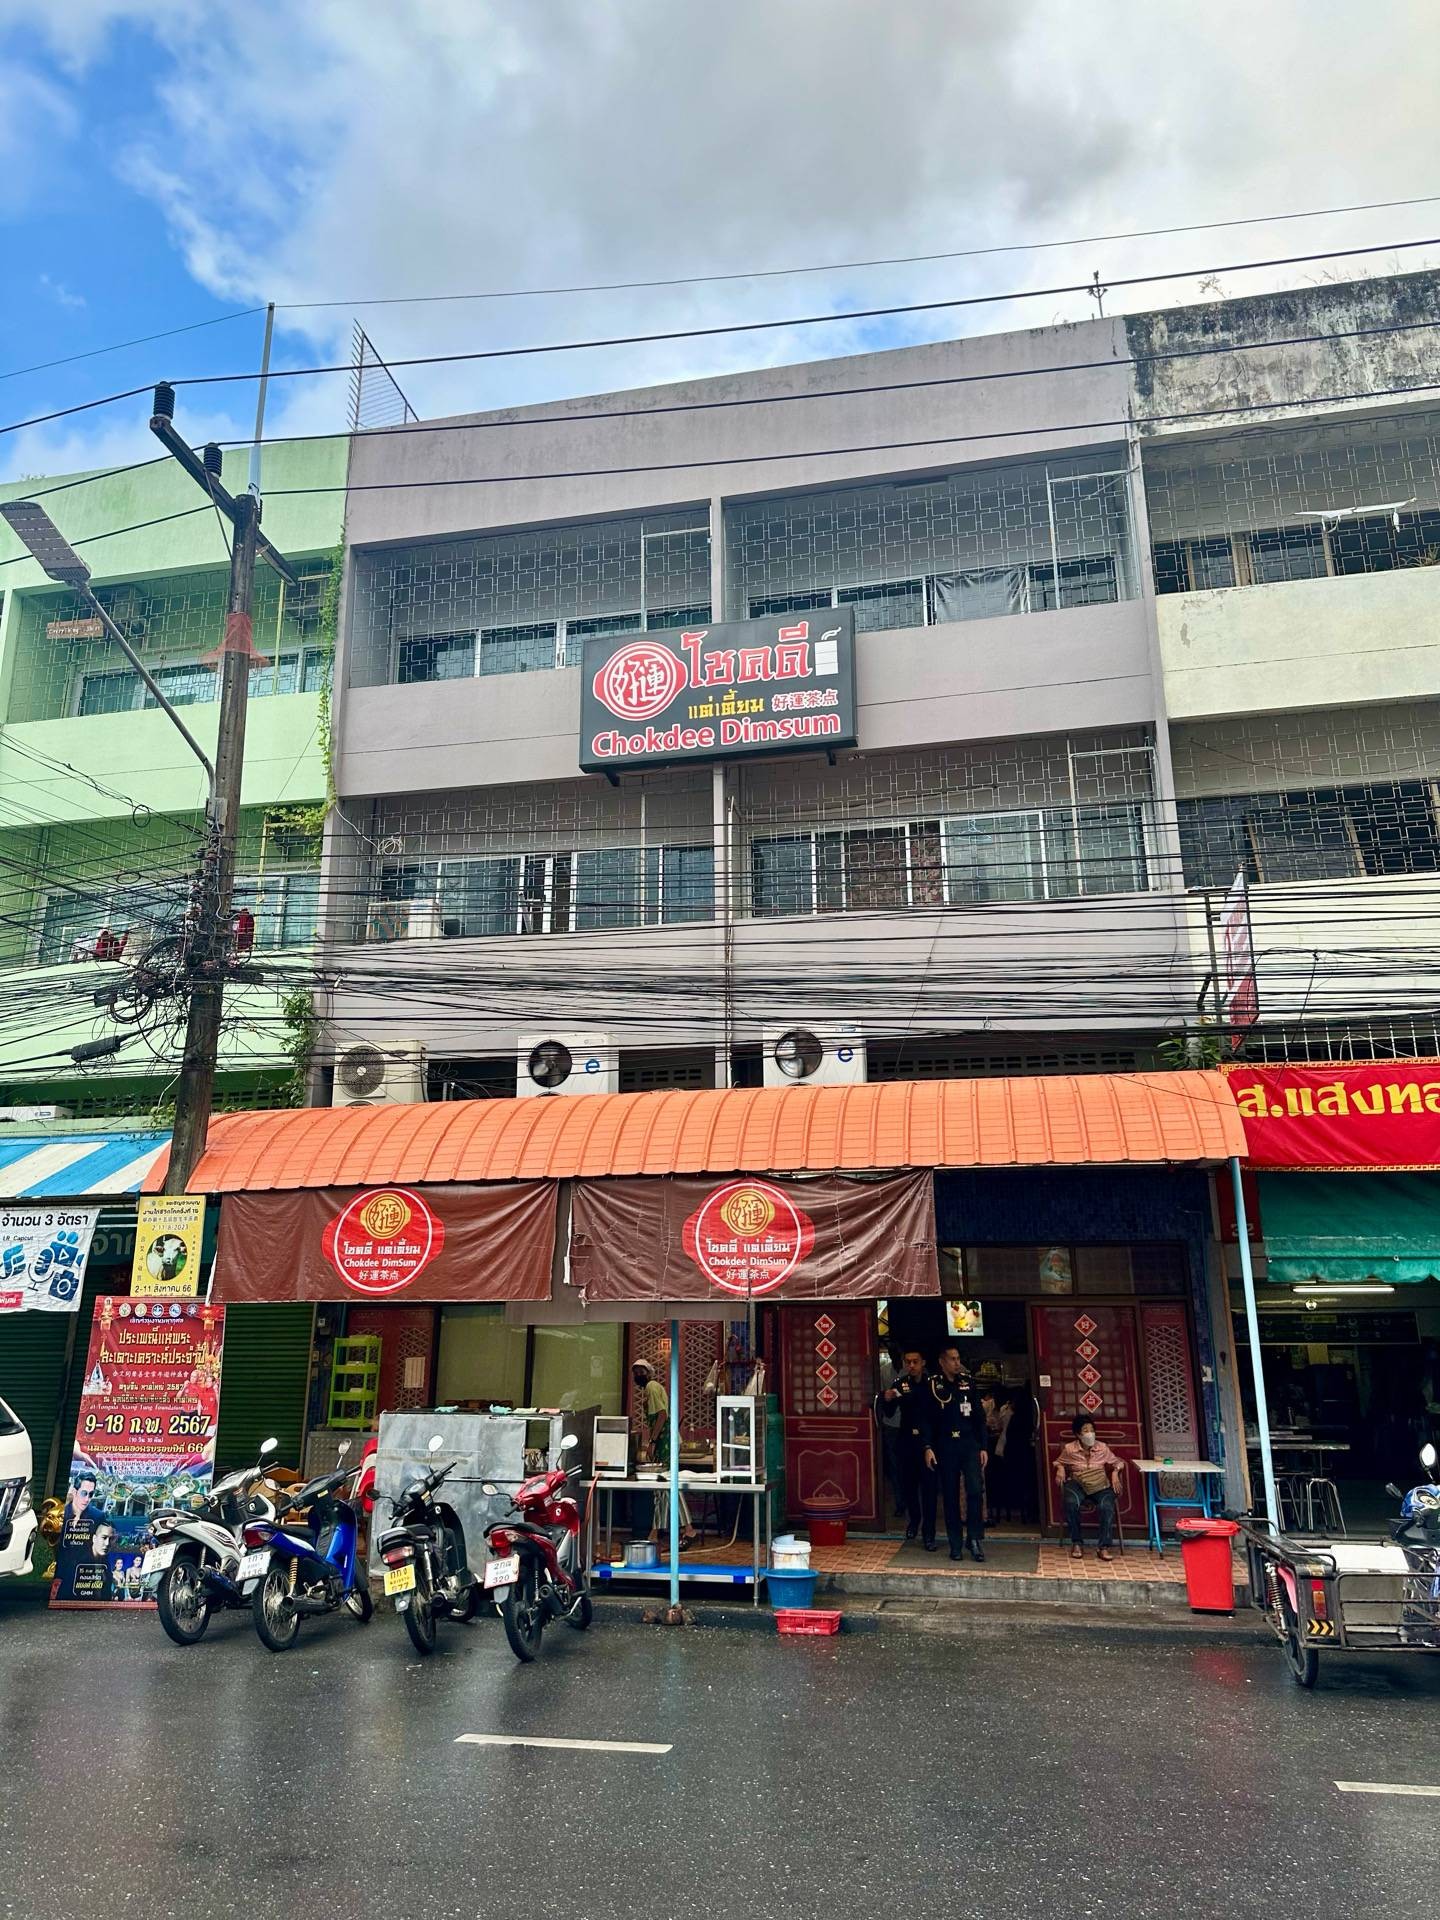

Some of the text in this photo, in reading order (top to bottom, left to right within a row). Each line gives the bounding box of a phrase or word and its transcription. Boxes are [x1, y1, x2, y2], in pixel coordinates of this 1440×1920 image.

[681, 621, 813, 688] โชคดี
[688, 689, 765, 719] แต่เตี้ยม
[771, 689, 838, 712] 好運茶点
[592, 713, 841, 758] Chokdee Dimsum
[2, 1212, 89, 1227] จำนวน 3 อัตรา
[344, 1258, 417, 1267] Chokdee DimSum
[709, 1257, 788, 1266] Chokdee DimSum
[85, 1414, 211, 1435] 9-18 ก.พ. 2567
[187, 1443, 204, 1453] 66
